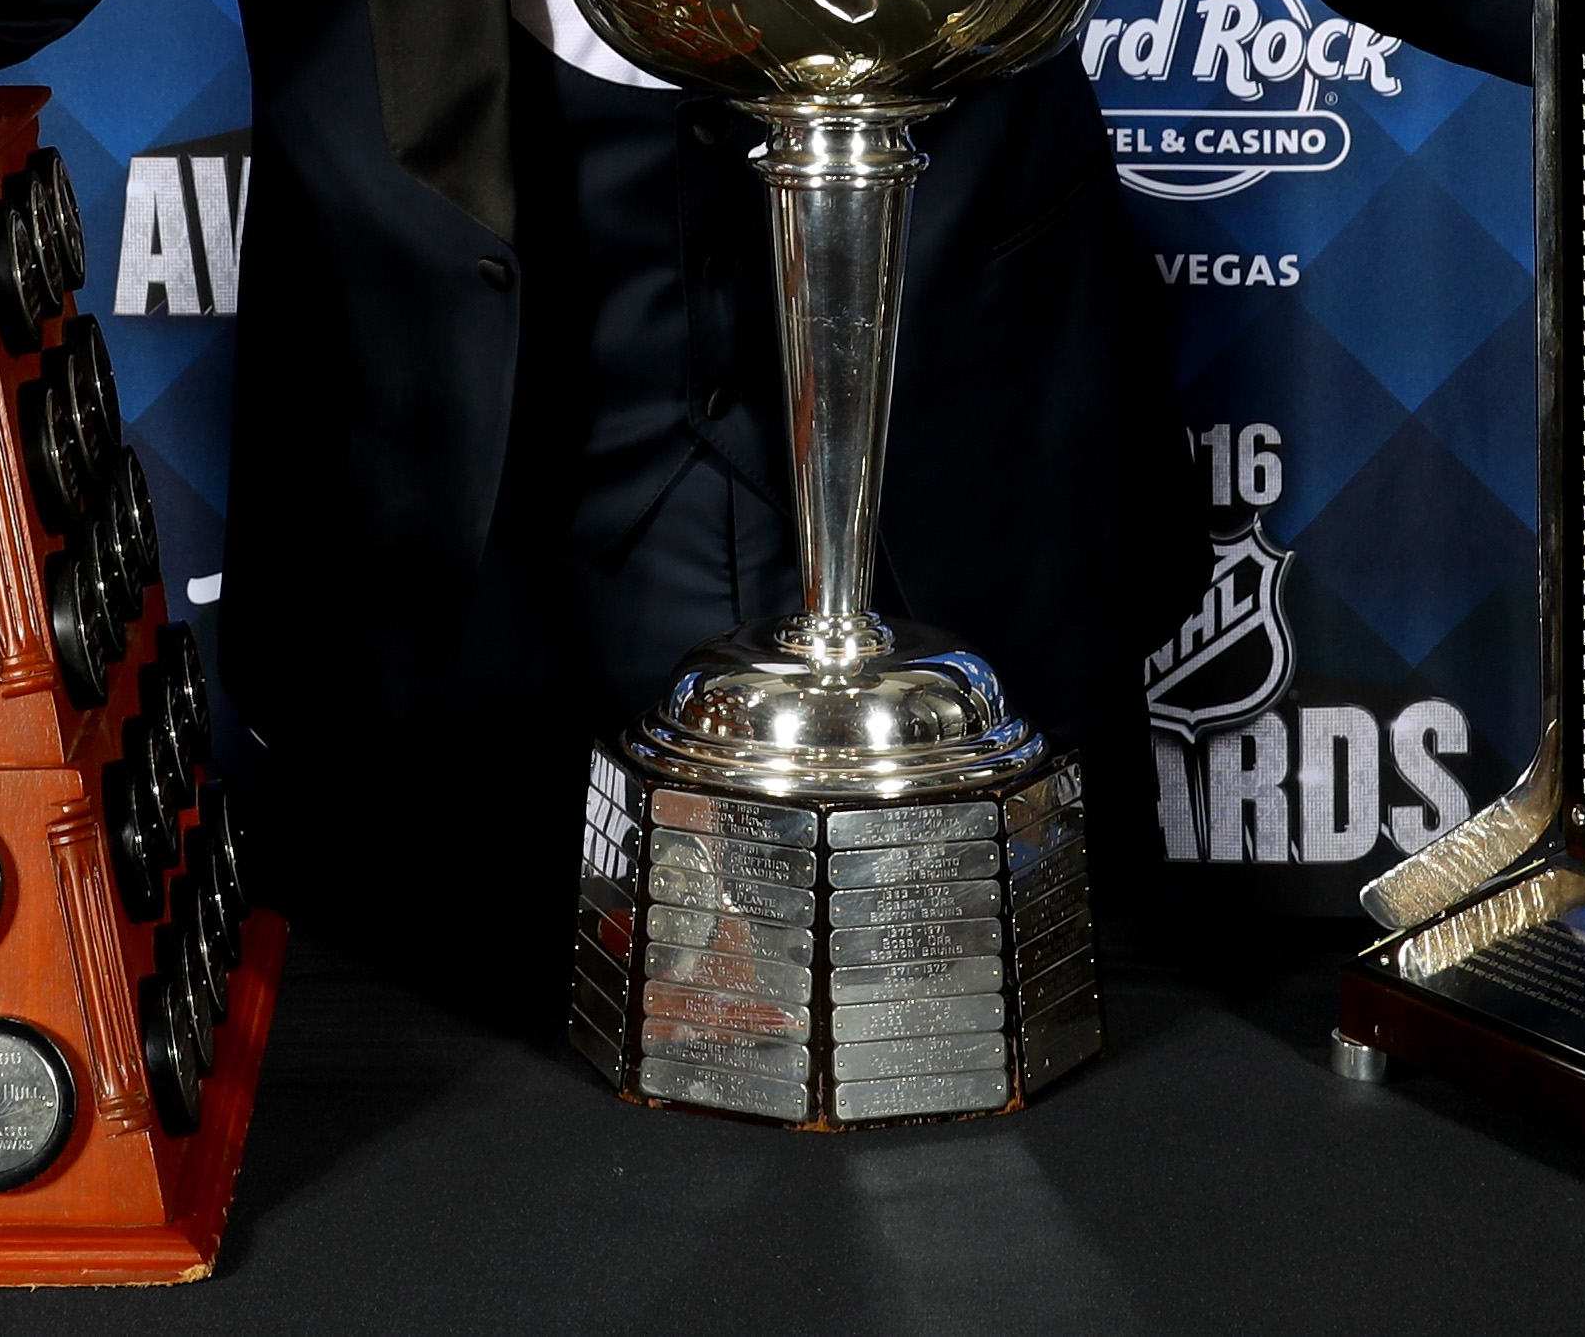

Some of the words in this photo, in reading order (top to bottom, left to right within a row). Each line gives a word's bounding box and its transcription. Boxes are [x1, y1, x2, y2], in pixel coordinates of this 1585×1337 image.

[1161, 129, 1186, 153] &
[1195, 128, 1327, 154] CASINO
[1155, 254, 1301, 287] VEGAS
[1187, 423, 1283, 506] 16
